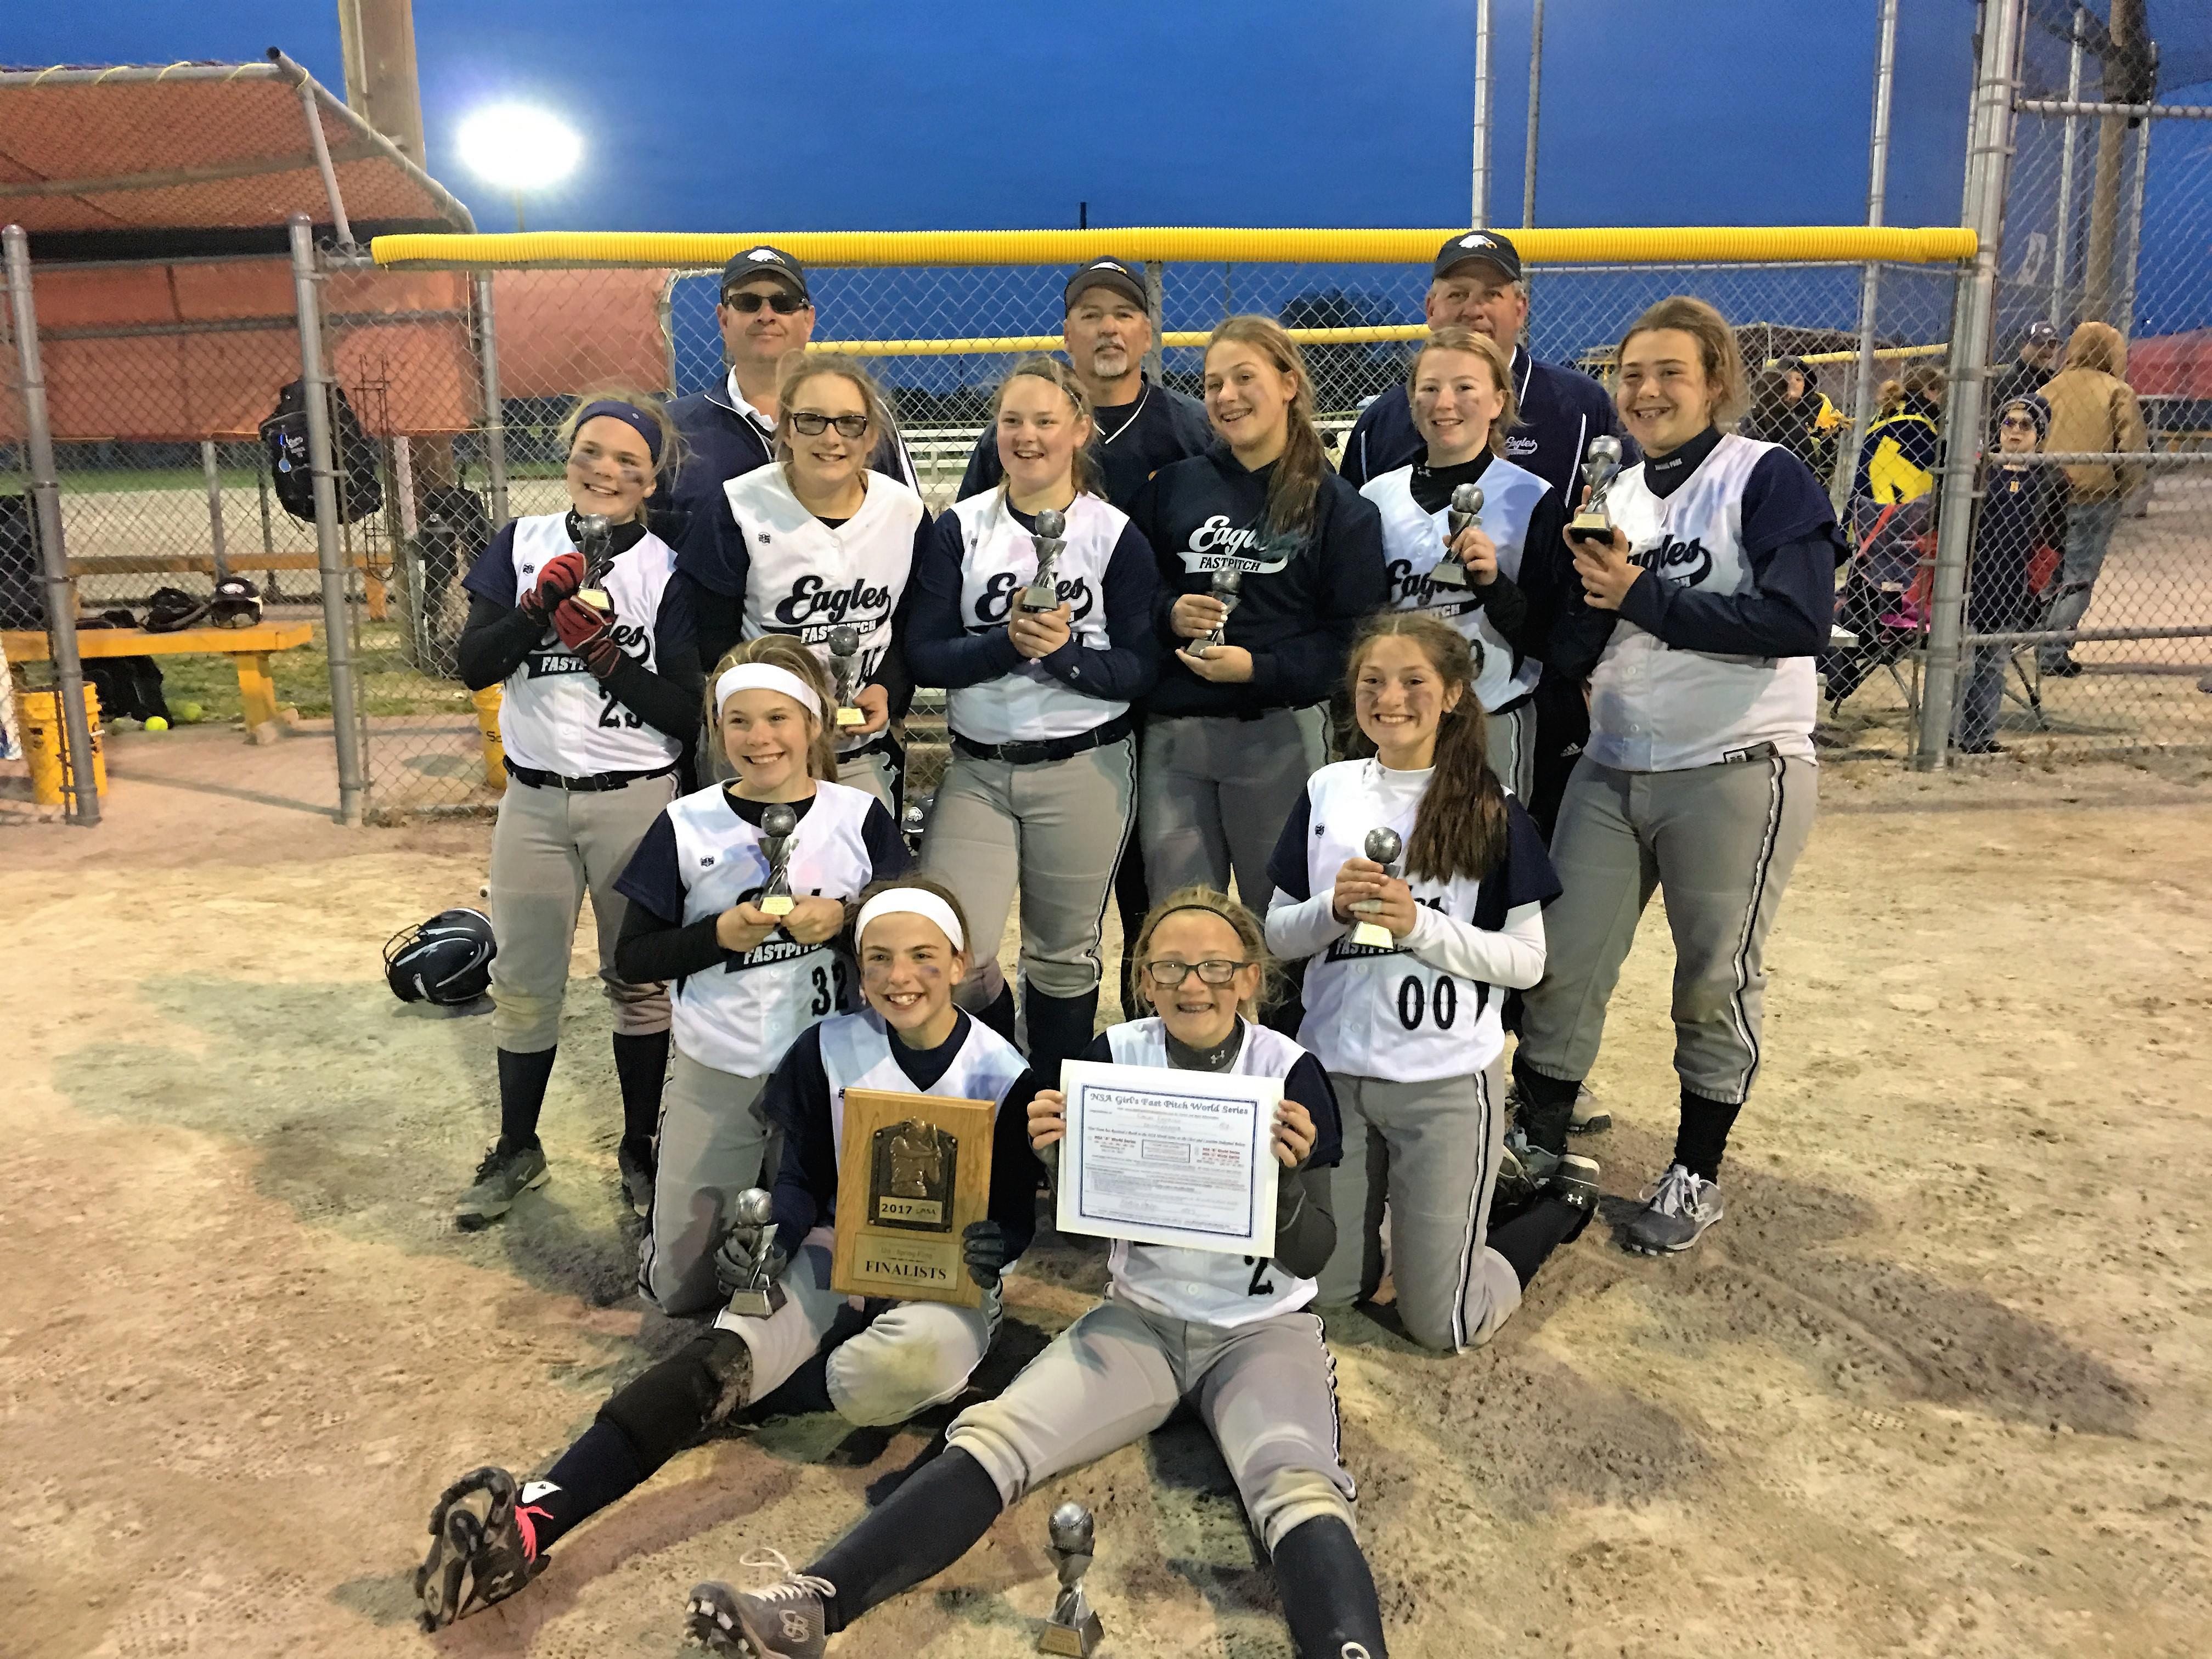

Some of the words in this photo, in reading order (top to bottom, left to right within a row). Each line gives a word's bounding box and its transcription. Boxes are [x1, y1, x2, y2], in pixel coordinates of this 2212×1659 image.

[1189, 515, 1265, 557] Eagl
[1199, 556, 1261, 572] FASTPITCH
[775, 575, 890, 625] Eagles
[811, 961, 849, 1017] 32
[1398, 975, 1458, 1030] 00
[1090, 1093, 1112, 1102] NSA
[1115, 1095, 1139, 1105] Girl's
[1141, 1098, 1162, 1107] Fast
[1164, 1101, 1188, 1110] Pitch
[1190, 1103, 1221, 1113] World
[1221, 1106, 1248, 1115] Series
[882, 1204, 912, 1215] 2017
[866, 1261, 947, 1280] FINALISTS
